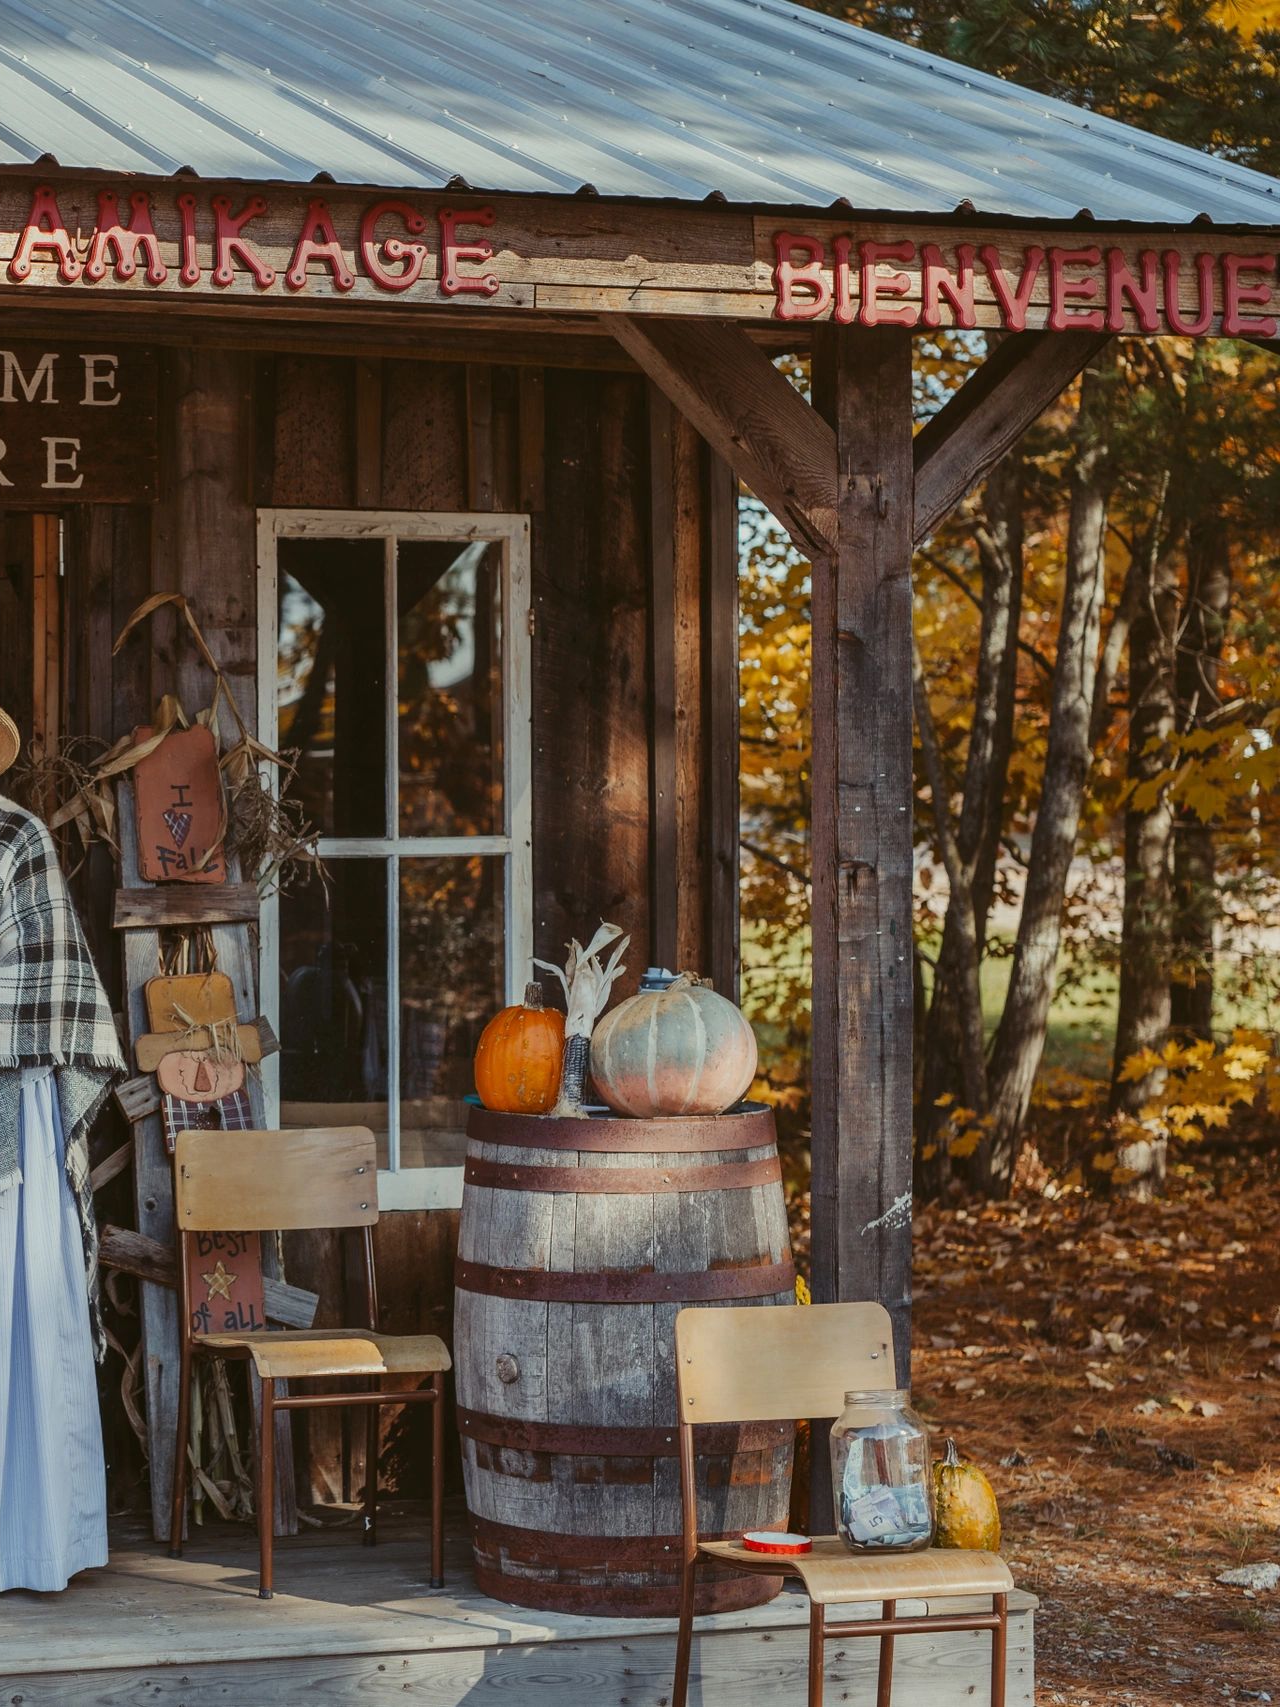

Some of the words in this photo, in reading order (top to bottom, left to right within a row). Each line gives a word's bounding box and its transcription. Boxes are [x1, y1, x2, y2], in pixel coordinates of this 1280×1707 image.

[773, 231, 1277, 337] BIENVENUE
[170, 784, 193, 808] I
[868, 1515, 883, 1528] 5
